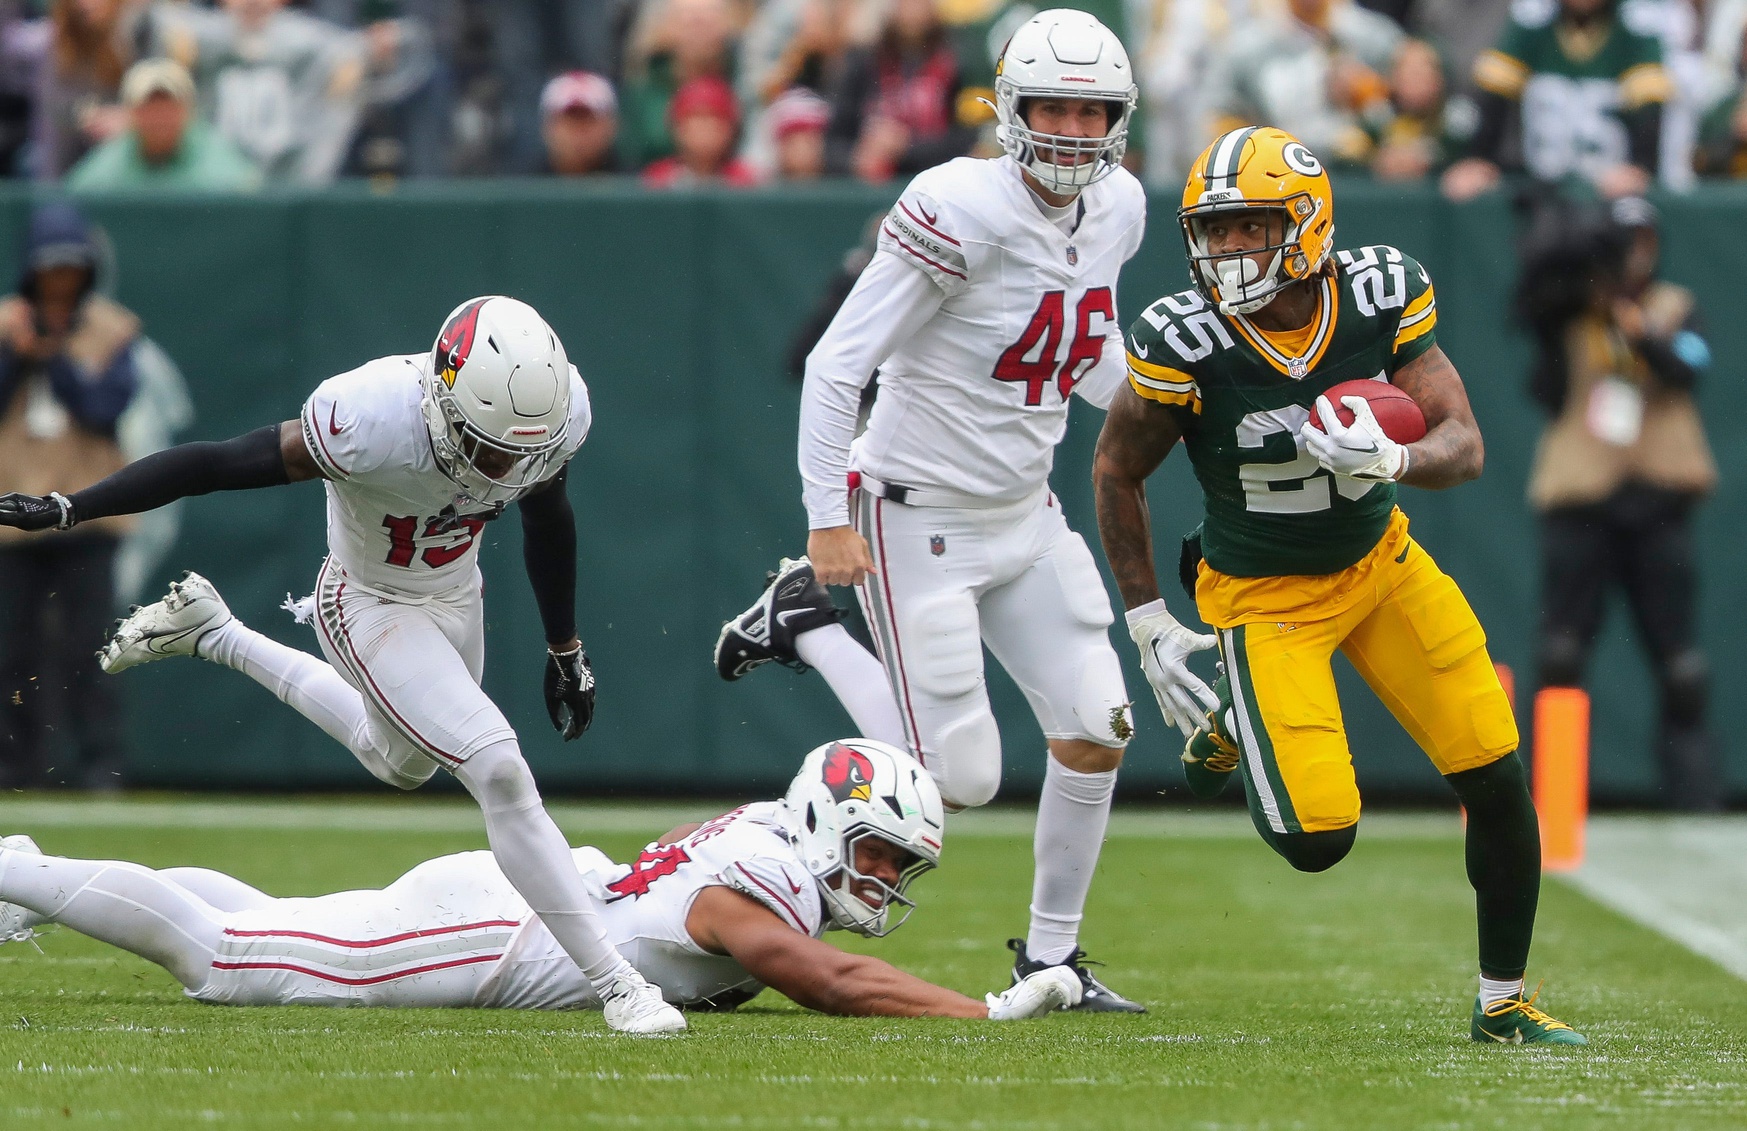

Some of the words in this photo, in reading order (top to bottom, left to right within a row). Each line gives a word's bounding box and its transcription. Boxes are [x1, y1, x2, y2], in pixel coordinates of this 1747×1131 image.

[891, 214, 941, 254] CARDINALS
[1337, 244, 1406, 318] 25
[990, 285, 1115, 407] 46
[1140, 288, 1236, 362] 25
[1235, 369, 1388, 514] 2
